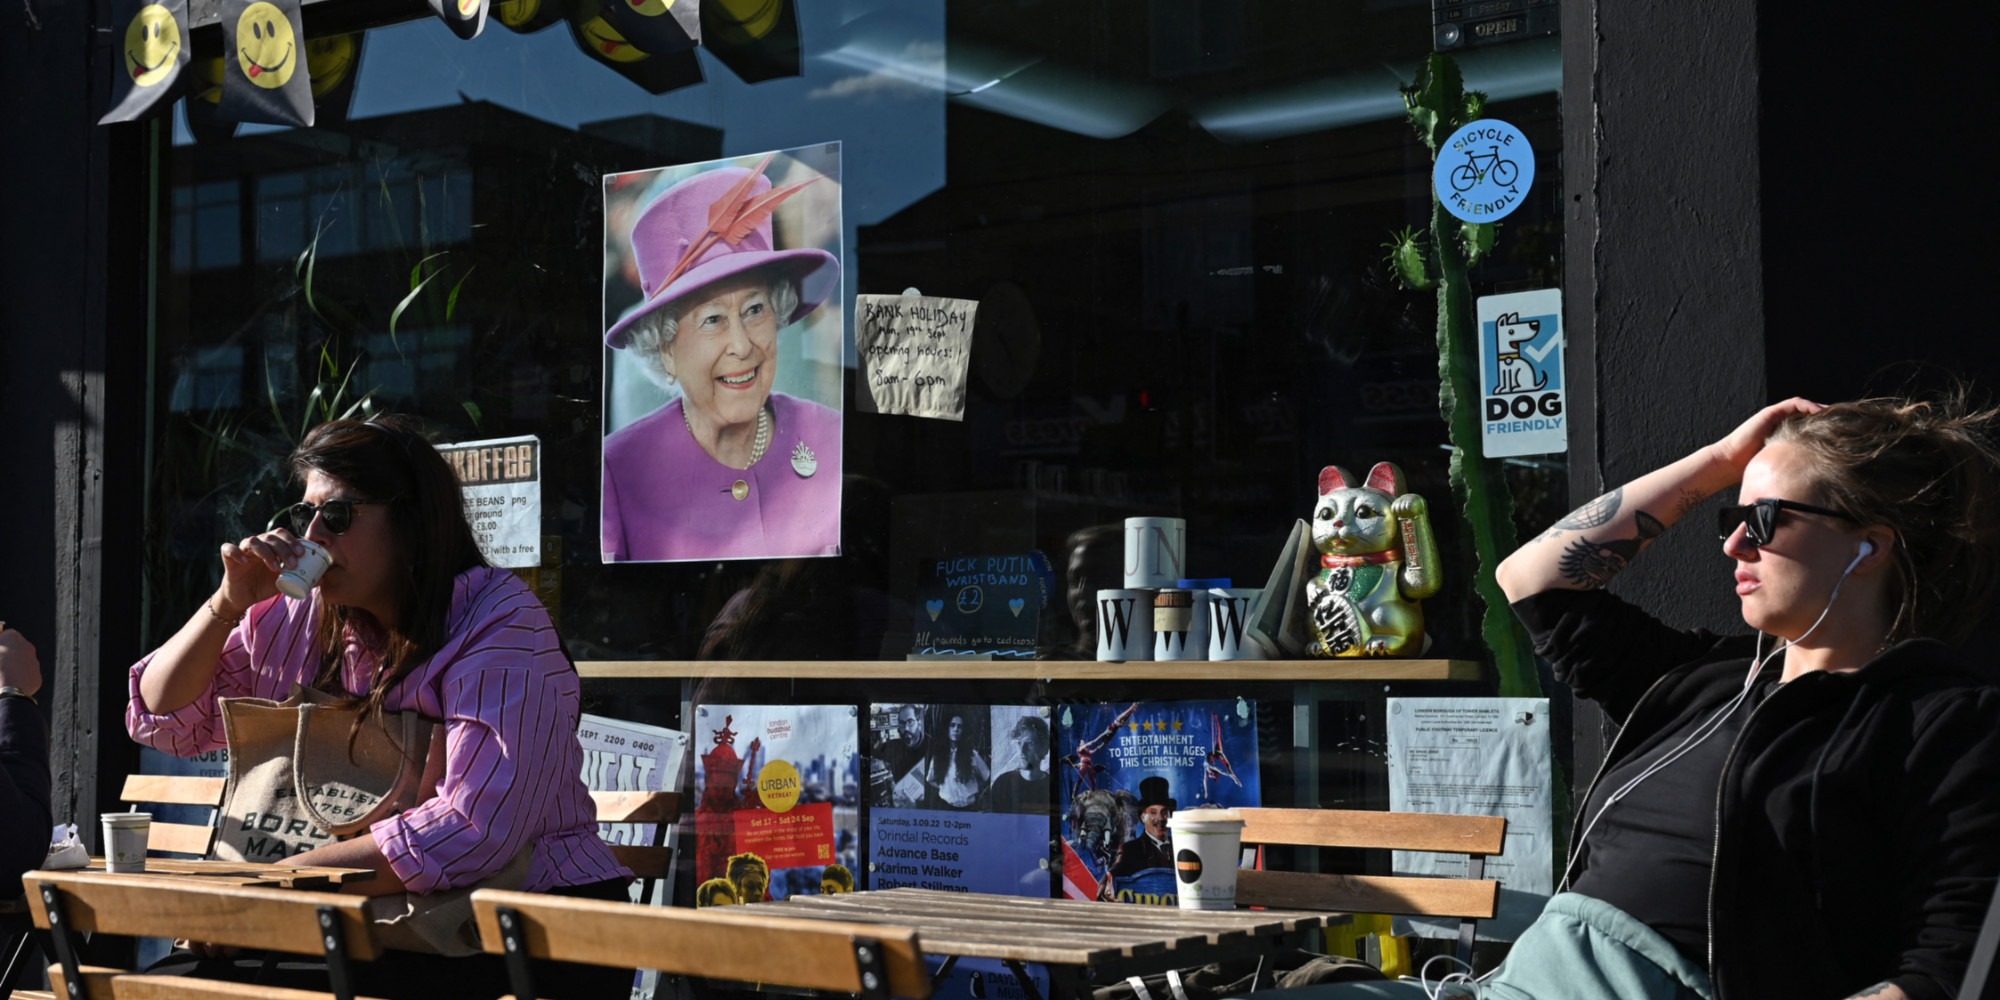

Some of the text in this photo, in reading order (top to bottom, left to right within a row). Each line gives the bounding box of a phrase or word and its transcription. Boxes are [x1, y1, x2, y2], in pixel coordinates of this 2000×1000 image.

[1475, 18, 1518, 37] OPEN
[1453, 128, 1514, 152] BICYCLE
[1450, 185, 1519, 215] FRIENDLY
[866, 303, 966, 332] BANK HOLIDAY
[928, 328, 946, 342] Sept
[869, 345, 910, 364] opening
[914, 370, 945, 392] 6pm
[1485, 392, 1562, 422] DOG
[1487, 417, 1562, 434] FRIENDLY
[477, 496, 505, 507] BEANS
[475, 510, 502, 520] ground
[518, 544, 535, 554] free
[936, 556, 1036, 576] FUCK PUTIN
[945, 573, 1028, 588] WRISTBAND
[959, 589, 979, 605] £2
[1101, 598, 1136, 651] W
[1213, 597, 1250, 651] W
[580, 730, 654, 752] SEPT 2200 0400
[1109, 745, 1206, 758] TO DELIGHT ALL AGES
[1119, 757, 1139, 768] THIS
[761, 777, 797, 791] URBAN
[751, 819, 762, 827] Sat
[764, 818, 772, 826] 17
[779, 817, 790, 825] Sat
[791, 815, 800, 823] 24
[802, 815, 814, 823] Sep
[877, 817, 971, 830] Saturday, 3.09.22 12-2pm
[877, 829, 969, 846] Orindal Records
[877, 846, 959, 861] Advance Base
[877, 862, 963, 878] Karima Walker
[878, 878, 968, 893] Robert Stillman
